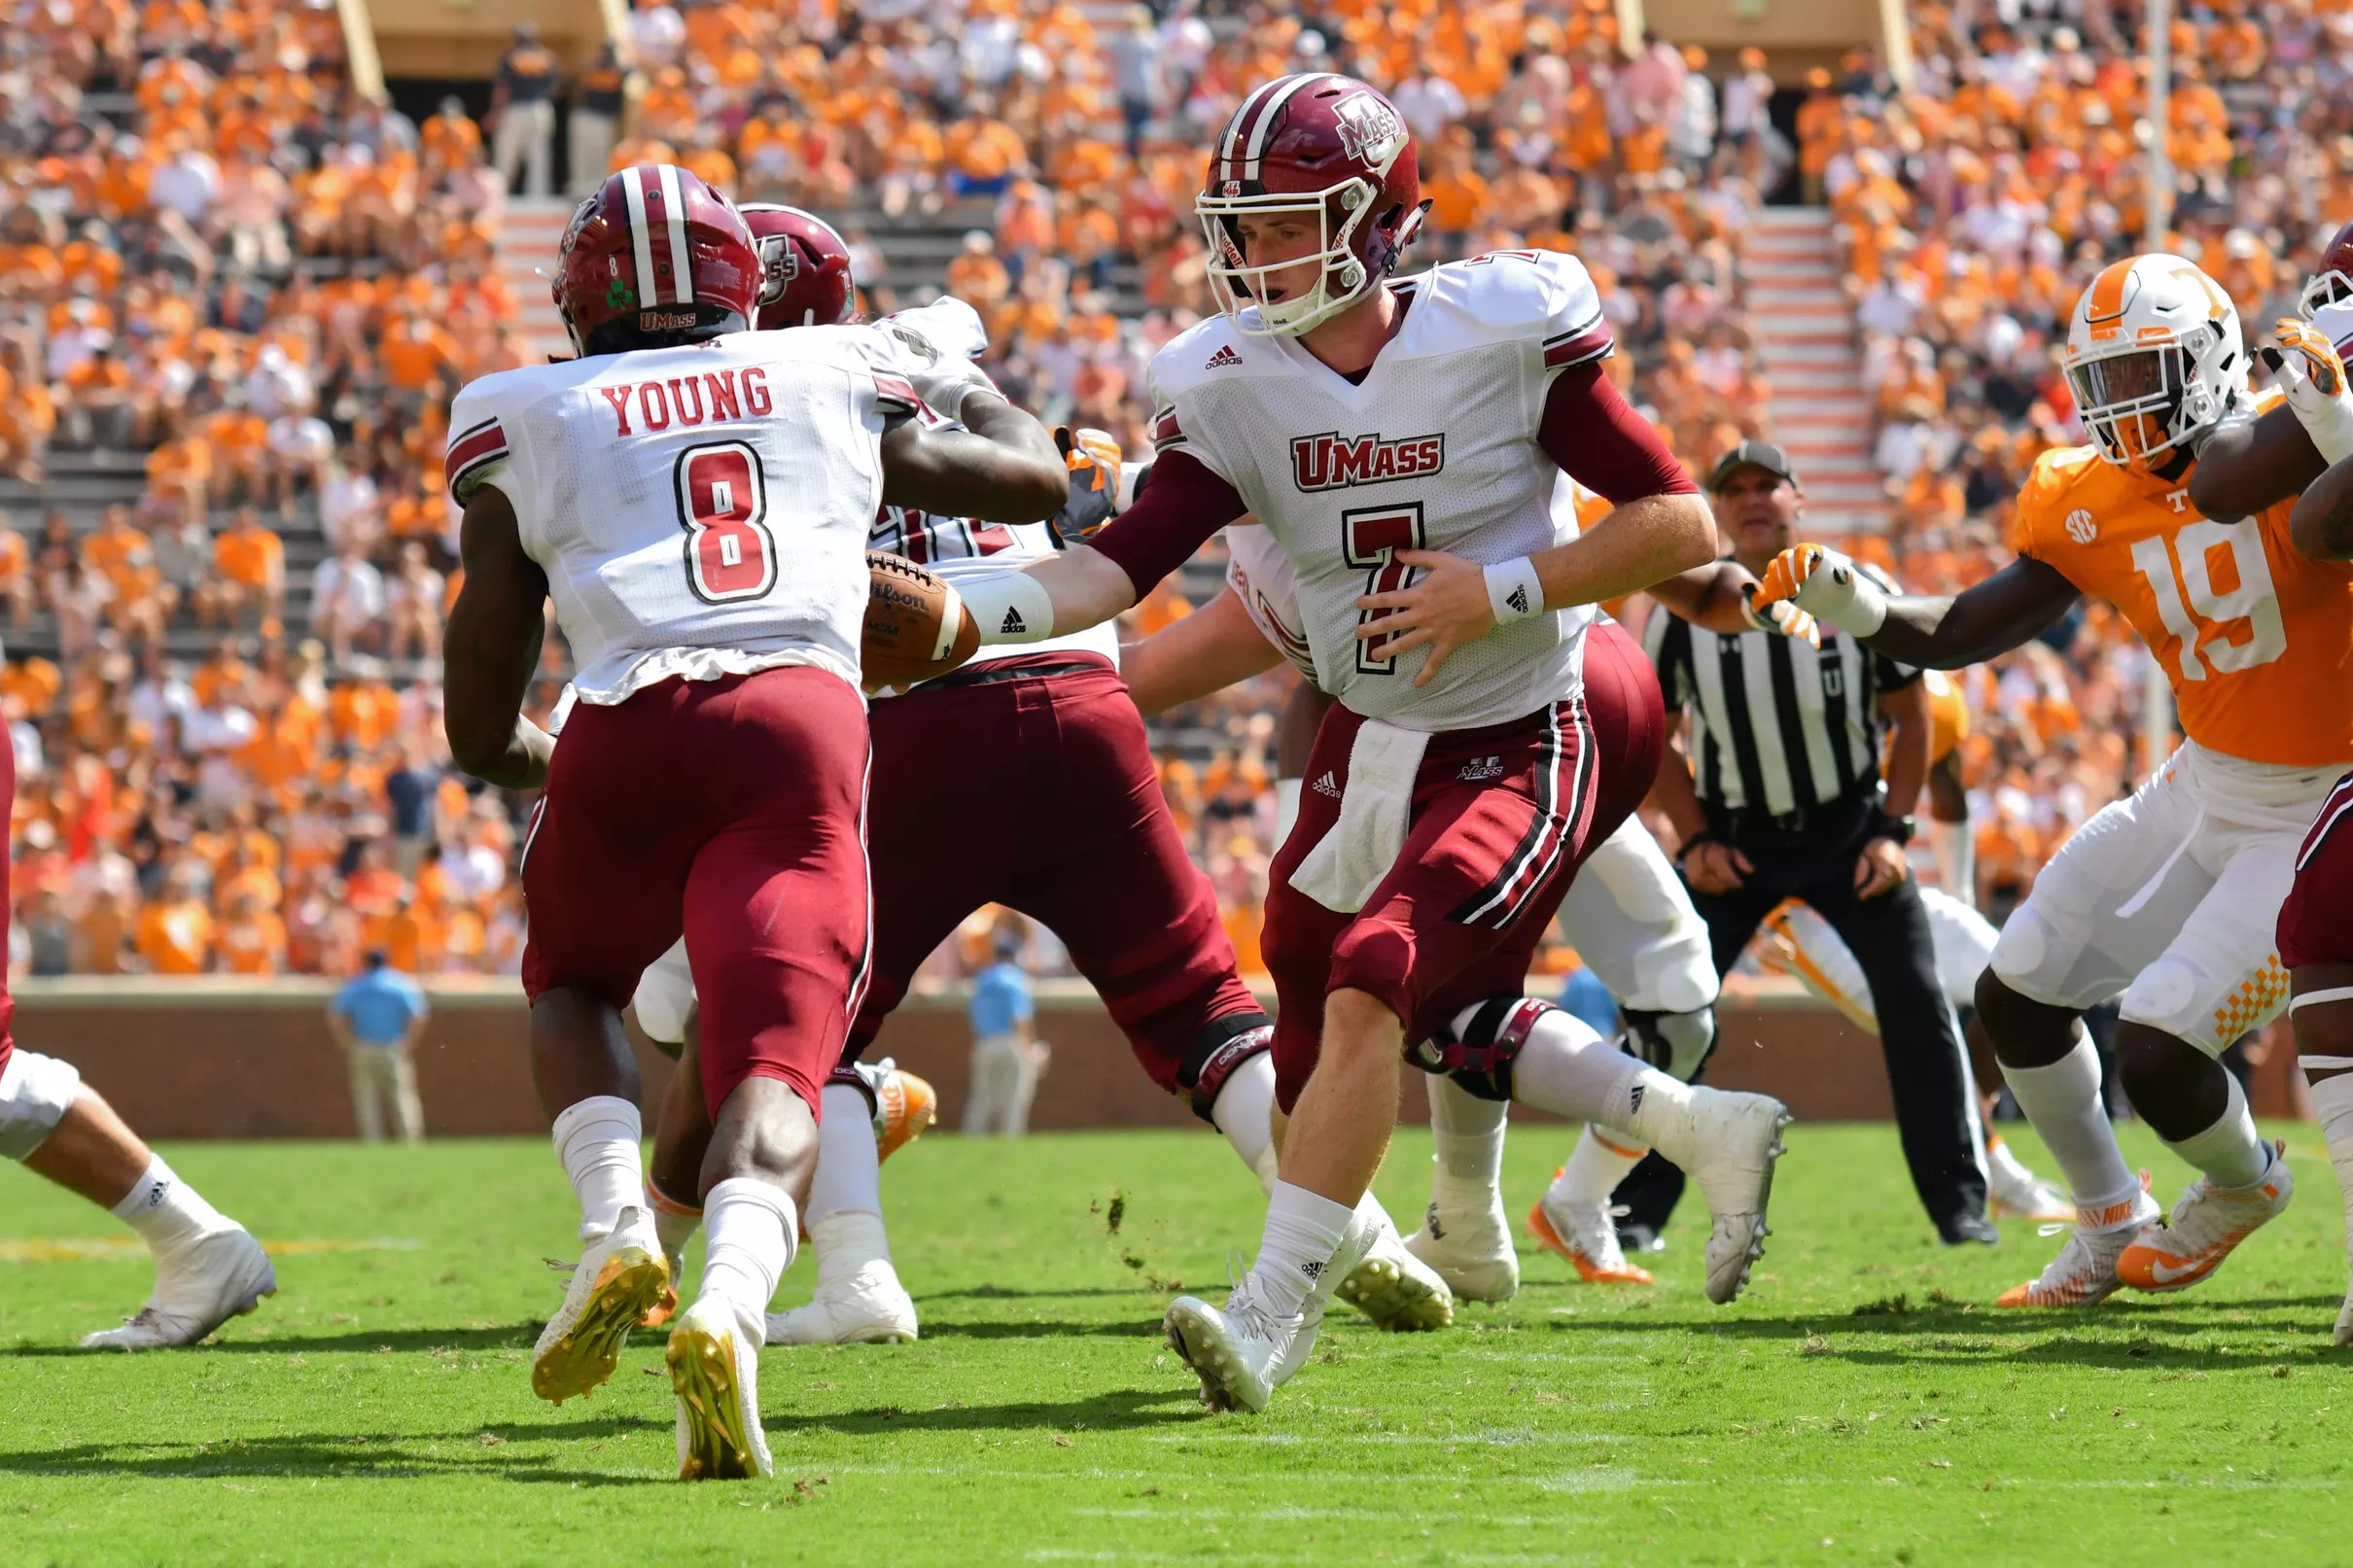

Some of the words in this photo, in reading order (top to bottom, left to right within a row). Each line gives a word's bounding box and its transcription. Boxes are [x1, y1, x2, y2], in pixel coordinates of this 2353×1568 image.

[609, 256, 618, 277] 8
[1206, 356, 1243, 370] adidas
[602, 367, 772, 436] YOUNG
[1290, 431, 1445, 493] UMASS
[2166, 488, 2188, 513] T
[673, 439, 778, 605] 8
[2065, 508, 2097, 544] SEC
[871, 583, 931, 613] ilson
[1342, 501, 1425, 675] 7
[1517, 583, 1528, 613] adidas
[2130, 514, 2287, 681] 19
[1824, 668, 1842, 697] U
[1313, 782, 1341, 798] adidas
[2103, 1198, 2132, 1227] NIKE
